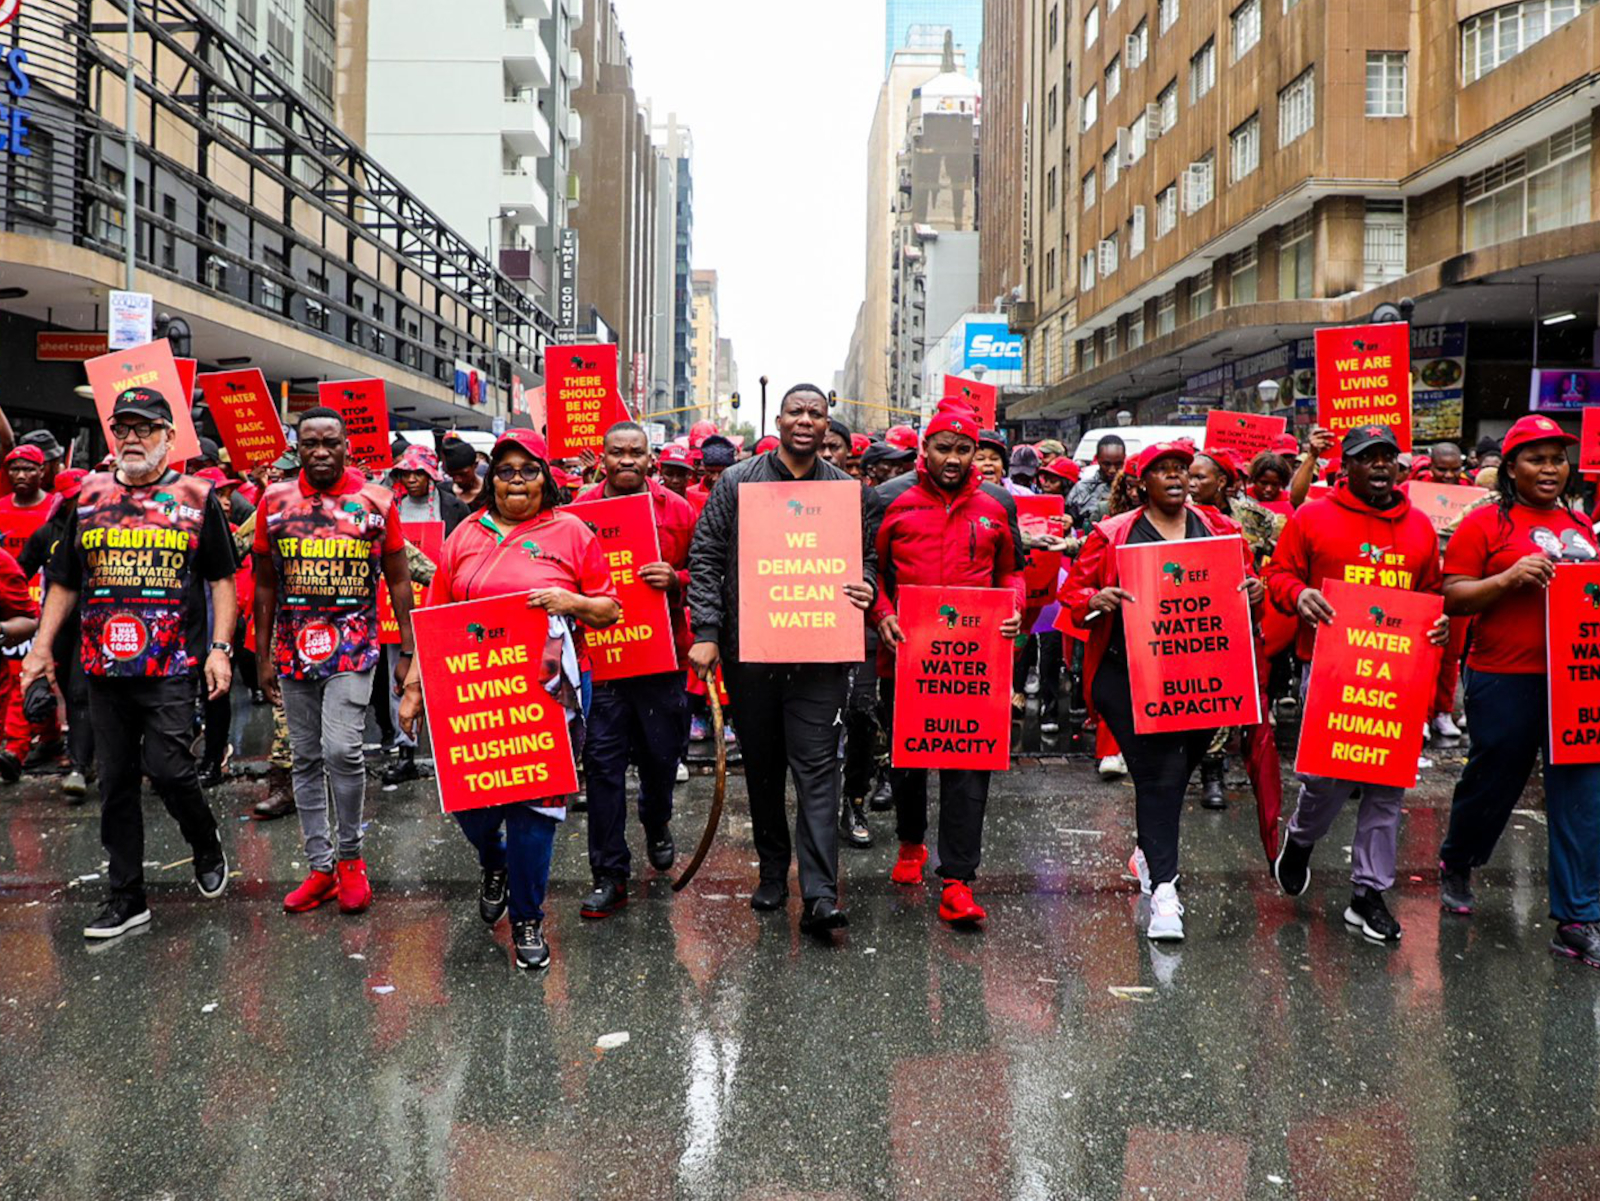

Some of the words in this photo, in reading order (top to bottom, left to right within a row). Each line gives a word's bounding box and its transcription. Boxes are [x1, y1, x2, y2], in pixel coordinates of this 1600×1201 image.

[562, 231, 574, 279] TEMPLE
[562, 286, 573, 326] COURT
[1335, 358, 1359, 372] WE
[1362, 355, 1392, 370] ARE
[111, 370, 159, 392] WATER
[563, 375, 602, 387] THERE
[1340, 375, 1389, 391] LIVING
[221, 392, 258, 405] WATER
[559, 388, 607, 400] SHOULD
[1332, 395, 1370, 410] WITH
[1373, 393, 1397, 407] NO
[234, 408, 245, 418] IS
[247, 408, 256, 417] A
[565, 401, 581, 412] BE
[583, 400, 601, 411] NO
[345, 416, 374, 426] ATER
[566, 412, 600, 423] PRICE
[1329, 412, 1402, 430] FLUSHING
[235, 421, 266, 433] BASIC
[572, 424, 596, 435] FOR
[236, 435, 276, 447] HUMAN
[564, 436, 605, 447] WATER
[245, 449, 275, 460] RIGHT
[179, 505, 201, 520] EFF
[1430, 515, 1453, 525] STO
[81, 527, 106, 549] EFF
[107, 527, 190, 551] GAUTENG
[601, 526, 621, 539] EFF
[785, 532, 817, 548] WE
[301, 538, 372, 559] GAUTENG
[87, 550, 153, 568] MARCH
[159, 550, 185, 569] TO
[757, 558, 846, 575] DEMAND
[137, 566, 176, 578] WATER
[350, 560, 370, 577] TO
[1188, 569, 1209, 583] EFF
[1344, 565, 1375, 585] EFF
[145, 577, 182, 588] WATER
[330, 576, 364, 586] WATER
[769, 585, 834, 602] CLEAN
[1160, 596, 1211, 615] STOP
[768, 611, 837, 628] WATER
[961, 616, 981, 627] EFF
[1152, 615, 1223, 636] WATER
[1386, 616, 1403, 628] EFF
[110, 633, 138, 642] 2025
[488, 627, 505, 639] EFF
[584, 624, 653, 647] EMAND
[1579, 622, 1600, 638] ST
[931, 641, 979, 656] STOP
[1148, 636, 1229, 657] TENDER
[1346, 627, 1412, 654] WATER
[446, 652, 482, 674] WE
[487, 644, 528, 668] ARE
[606, 647, 623, 663] IT
[1572, 643, 1600, 660] WA
[921, 659, 988, 676] WATER
[1356, 658, 1373, 677] IS
[1376, 662, 1392, 681] A
[1567, 665, 1600, 681] TEN
[456, 675, 528, 703] LIVING
[916, 679, 991, 696] TENDER
[1163, 677, 1223, 696] BUILD
[1342, 685, 1398, 710] BASIC
[1145, 695, 1244, 718] CAPACITY
[1578, 707, 1600, 723] BU
[449, 708, 505, 734] WITH
[510, 703, 544, 725] NO
[924, 718, 980, 733] BUILD
[1327, 712, 1402, 740] HUMAN
[905, 737, 997, 754] CAPACITY
[1562, 730, 1600, 746] CAP
[450, 732, 555, 765] FLUSHING
[1331, 741, 1390, 766] RIGHT
[464, 763, 549, 792] TOILETS
